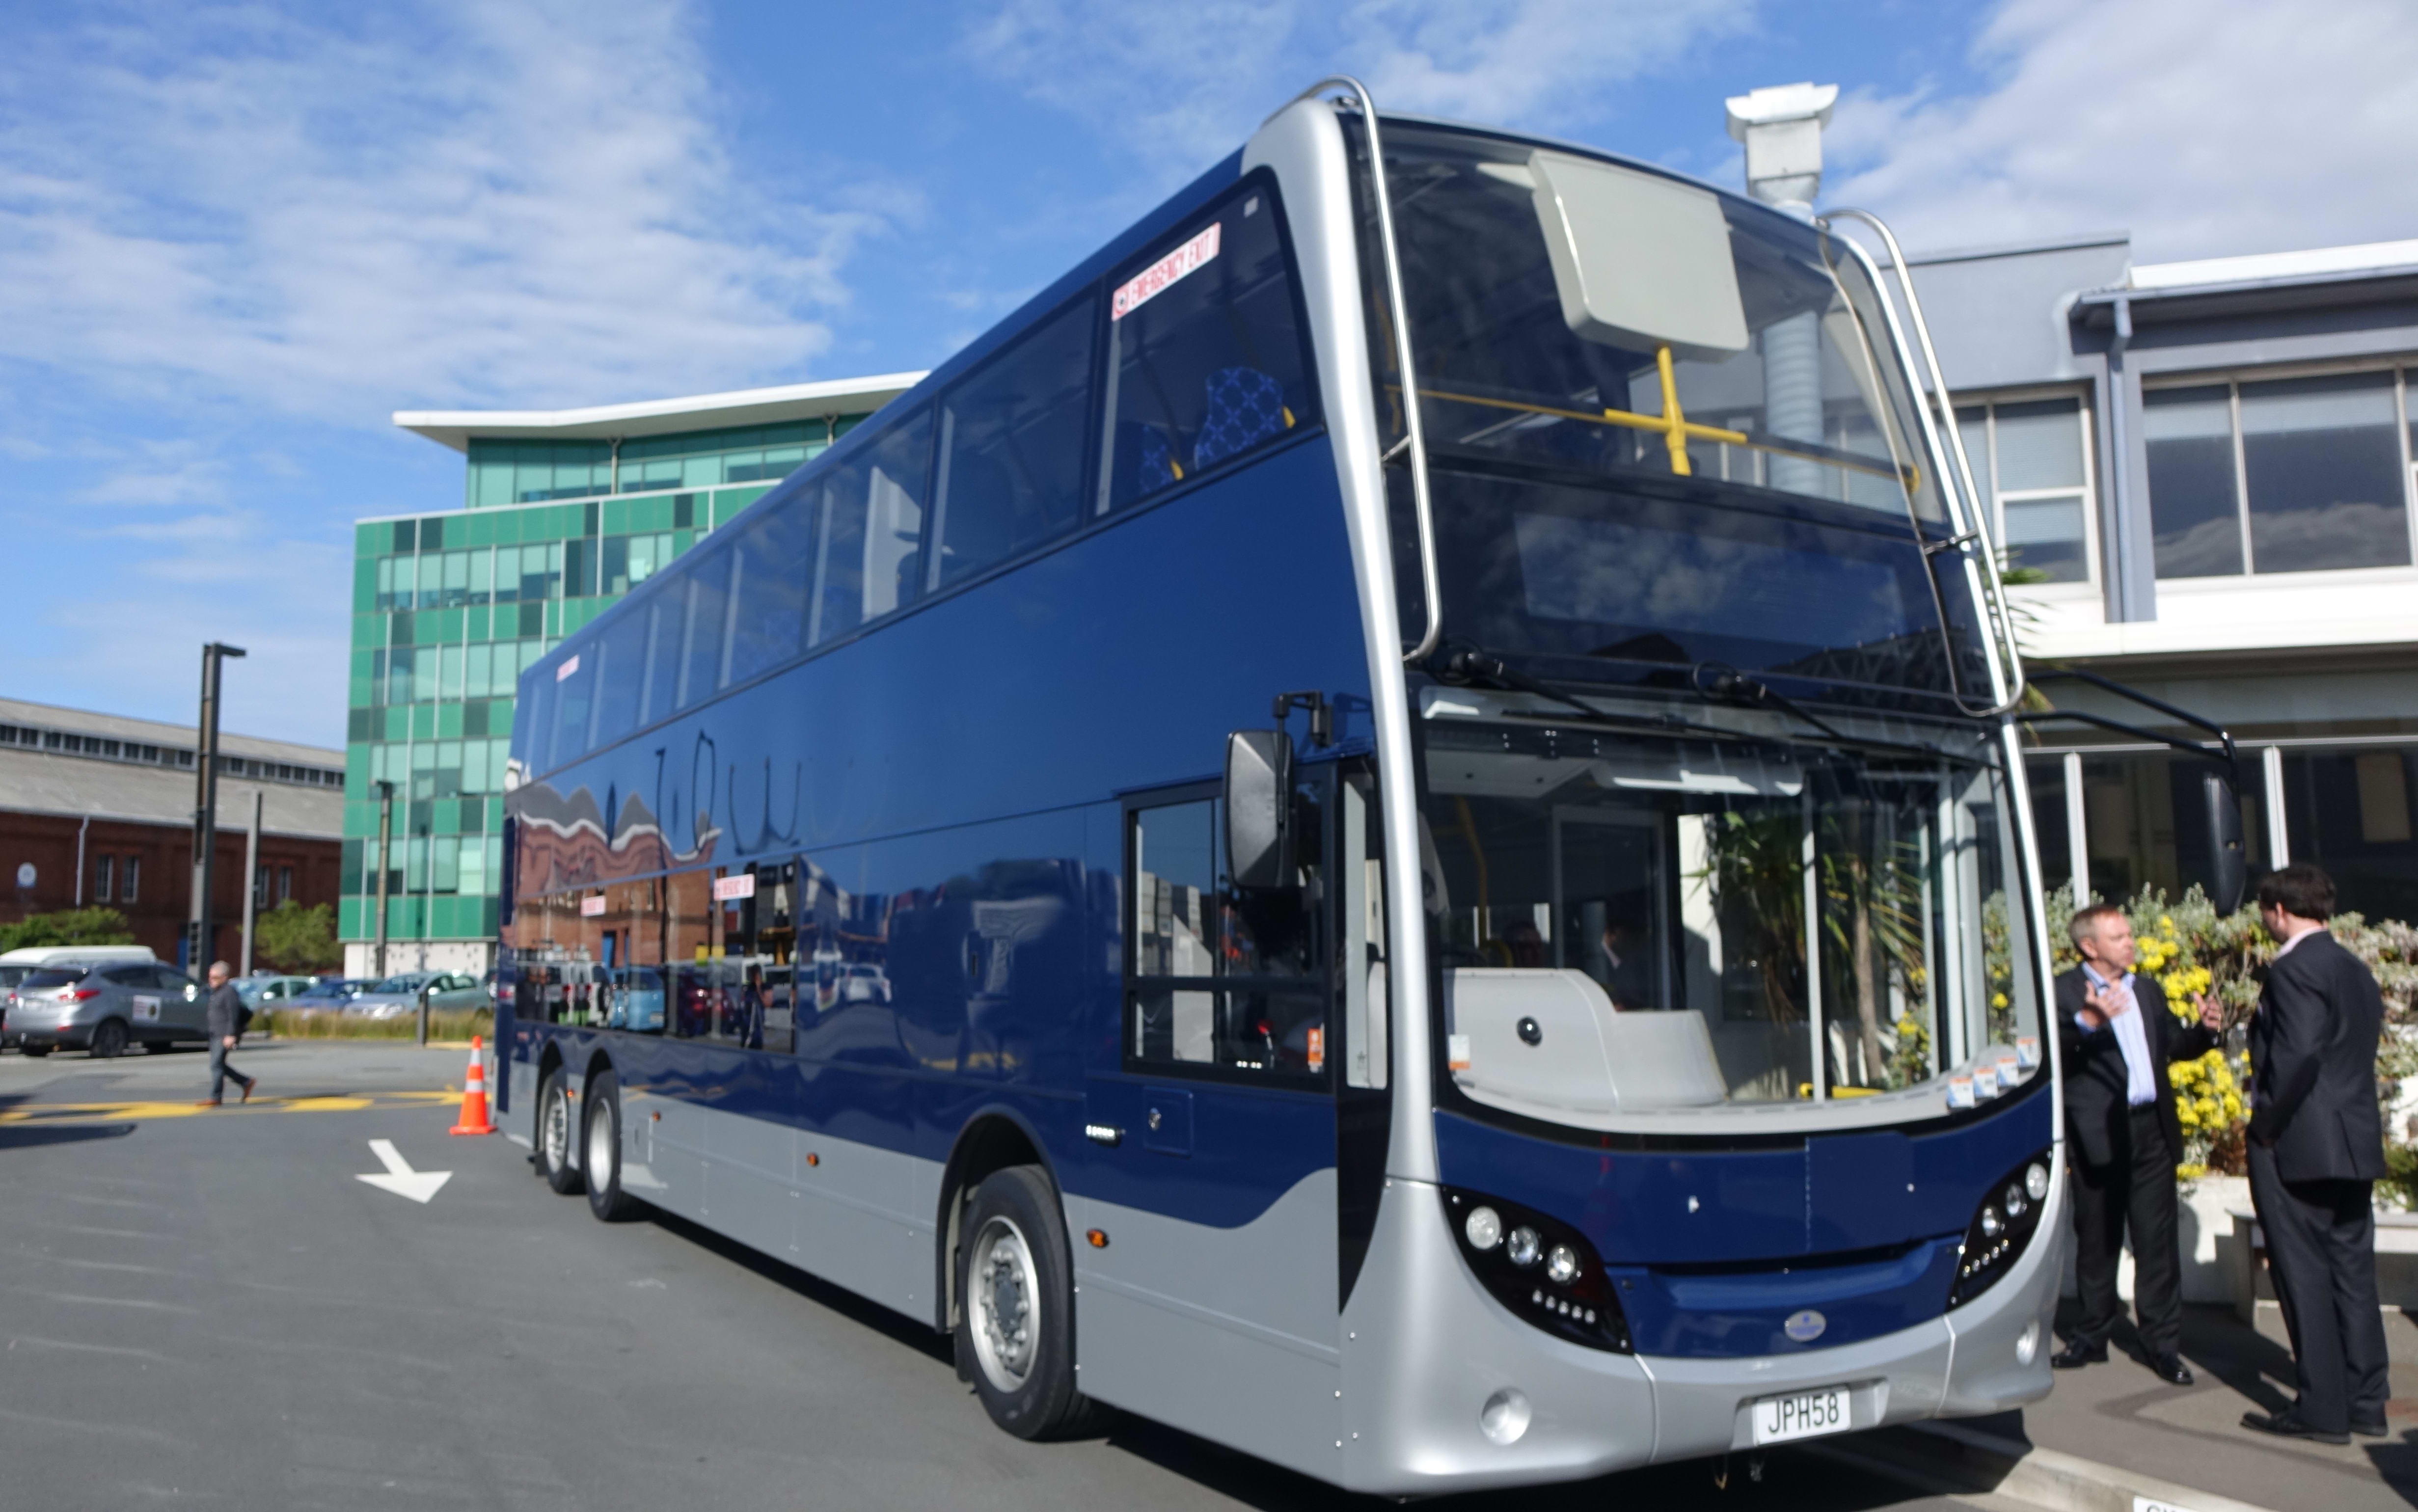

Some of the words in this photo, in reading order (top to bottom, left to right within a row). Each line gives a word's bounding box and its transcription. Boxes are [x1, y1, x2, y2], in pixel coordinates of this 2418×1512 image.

[1131, 251, 1185, 306] EMERGENCY
[1188, 232, 1211, 268] EXIT
[1768, 1391, 1839, 1434] JPH58
